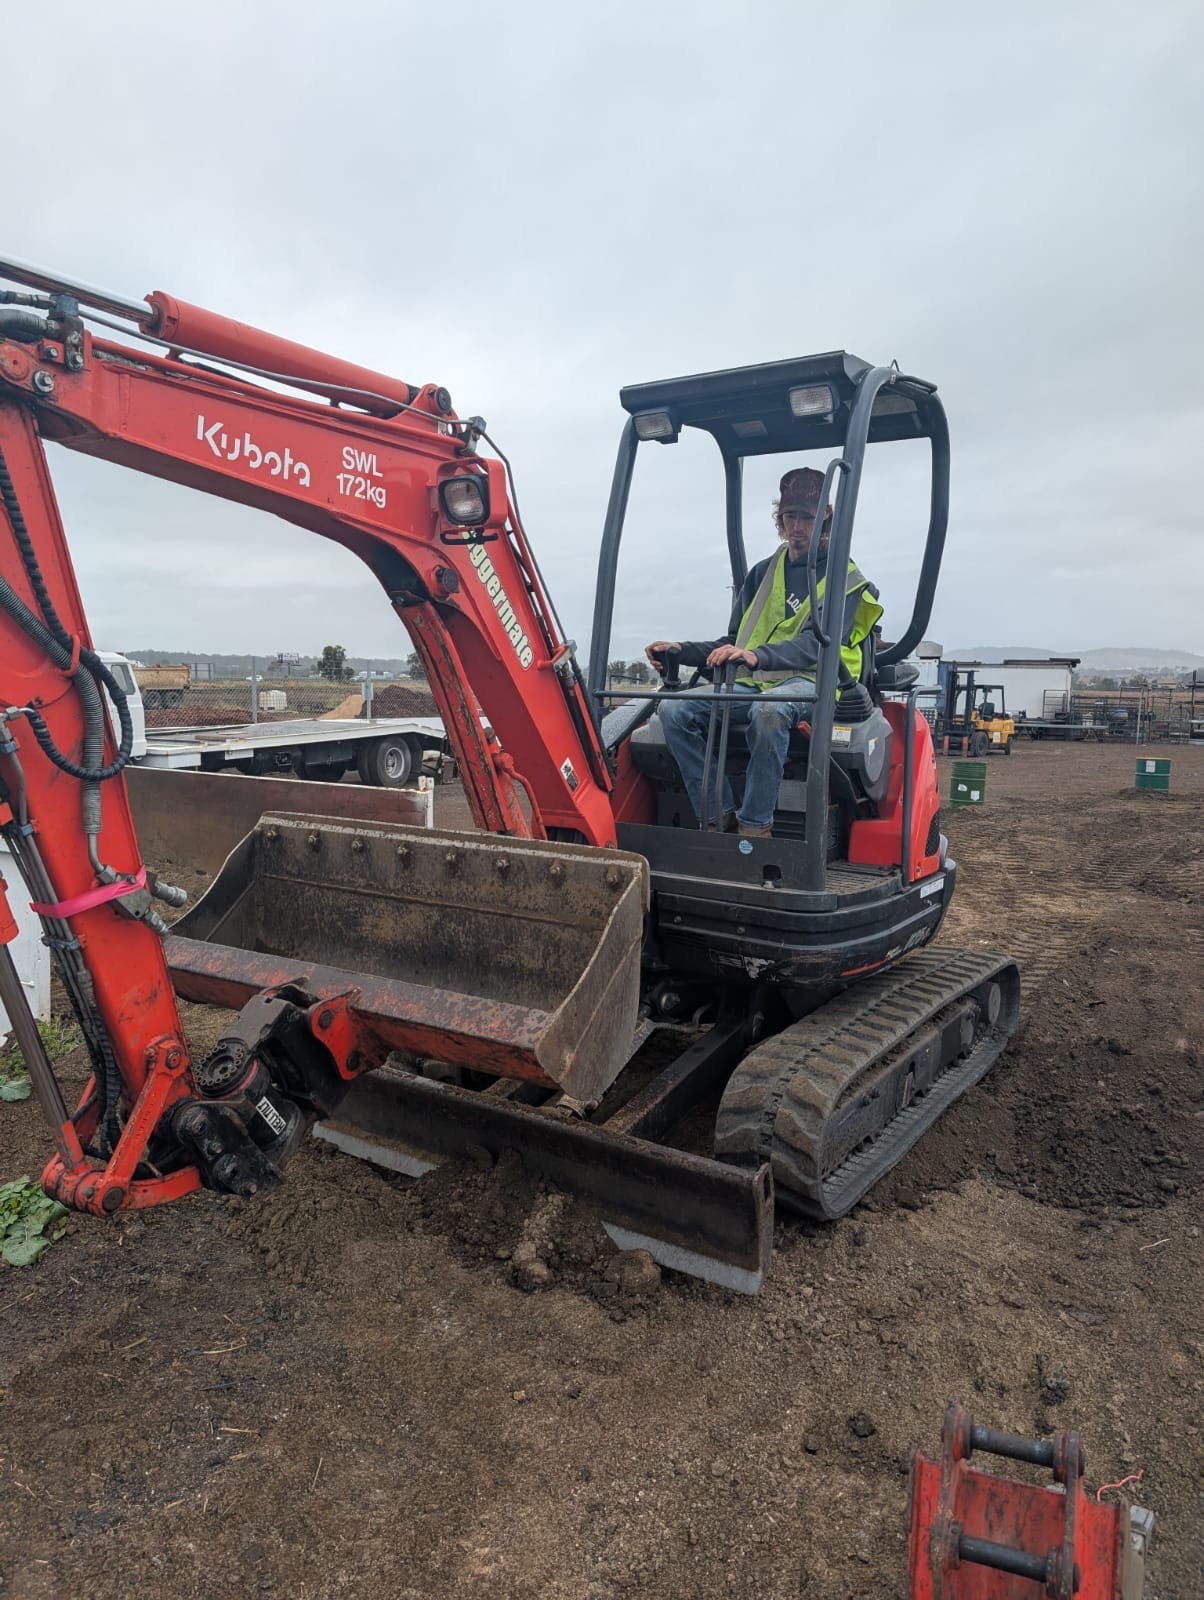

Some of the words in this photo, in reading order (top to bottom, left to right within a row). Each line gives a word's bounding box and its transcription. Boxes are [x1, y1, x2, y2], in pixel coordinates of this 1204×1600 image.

[197, 415, 310, 487] Kubota
[342, 446, 383, 478] SWL
[336, 473, 387, 509] 172kg
[460, 526, 534, 669] ggermate
